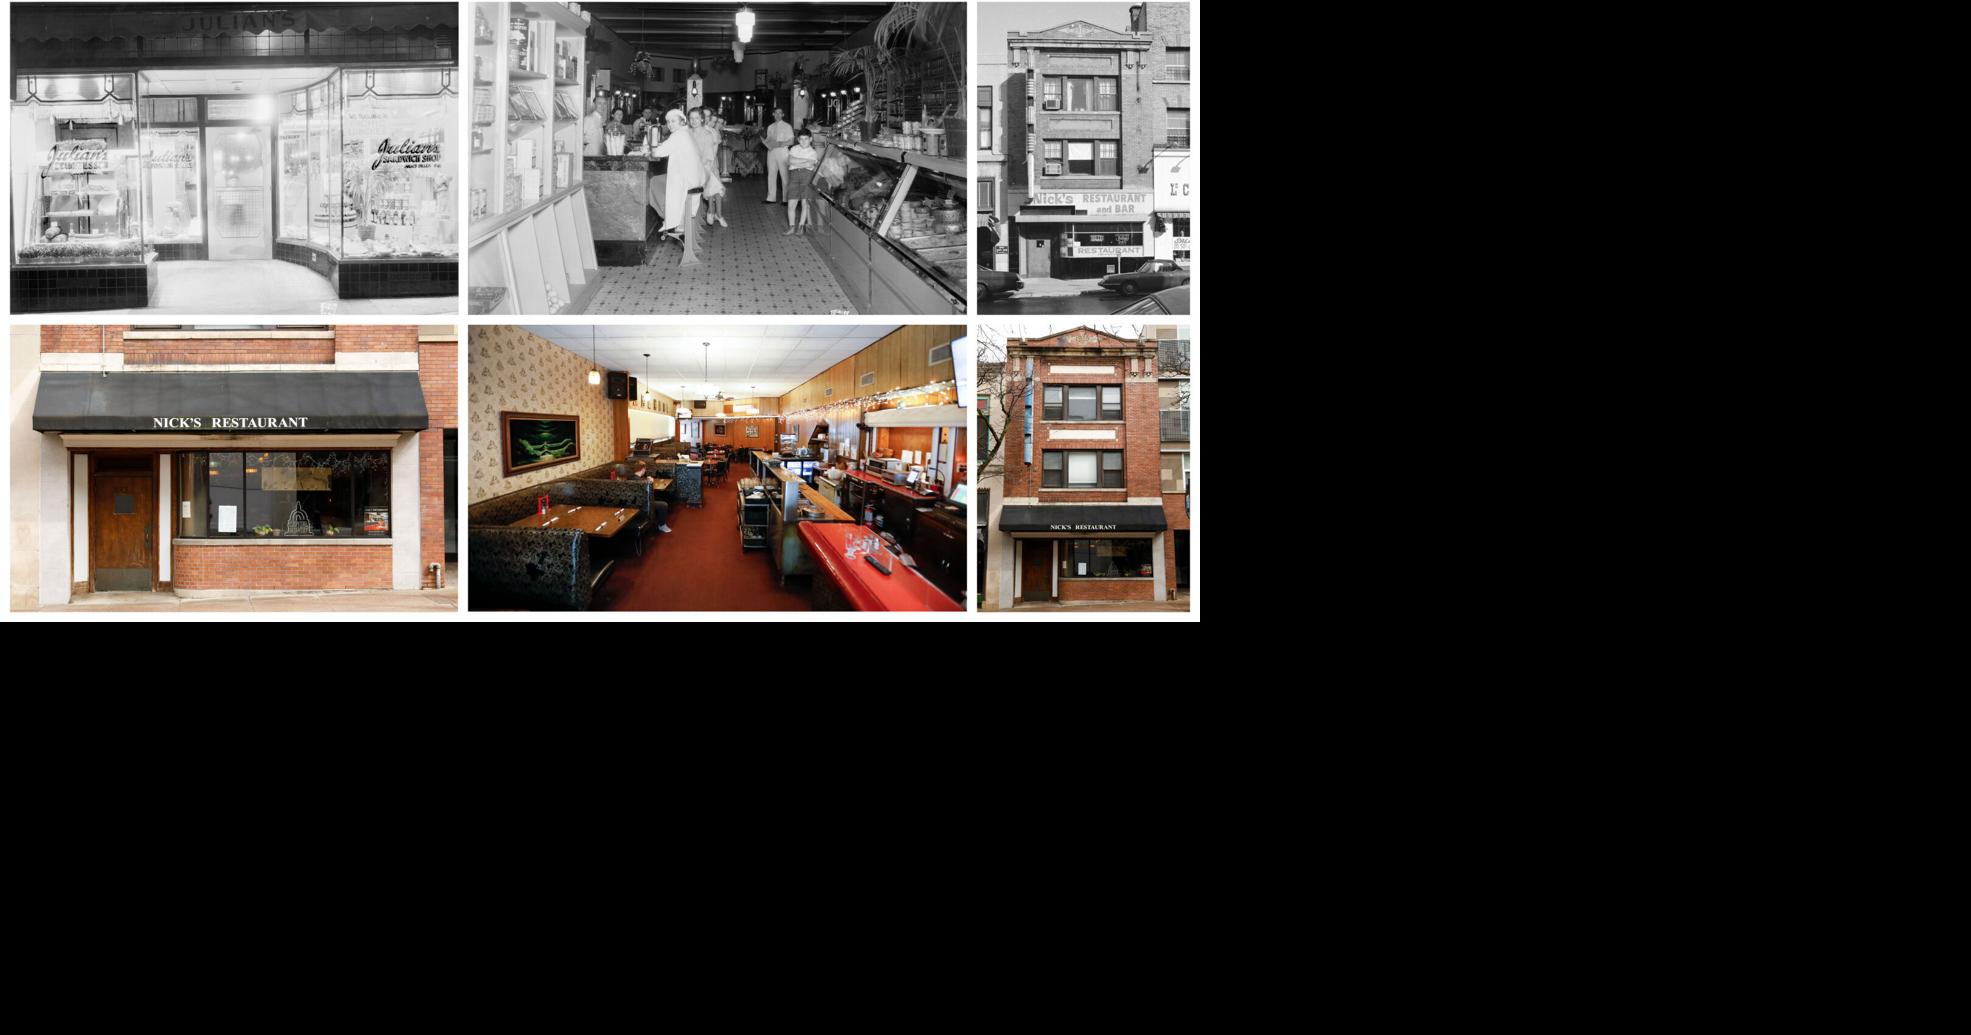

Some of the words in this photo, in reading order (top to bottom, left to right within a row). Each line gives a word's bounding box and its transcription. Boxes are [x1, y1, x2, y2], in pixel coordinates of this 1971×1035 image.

[1033, 193, 1074, 204] Nick's
[1082, 193, 1146, 203] RESTAURANT
[1096, 205, 1112, 213] and
[1115, 204, 1135, 213] BAR
[153, 417, 201, 428] NICK'S
[212, 417, 308, 428] RESTAURANT
